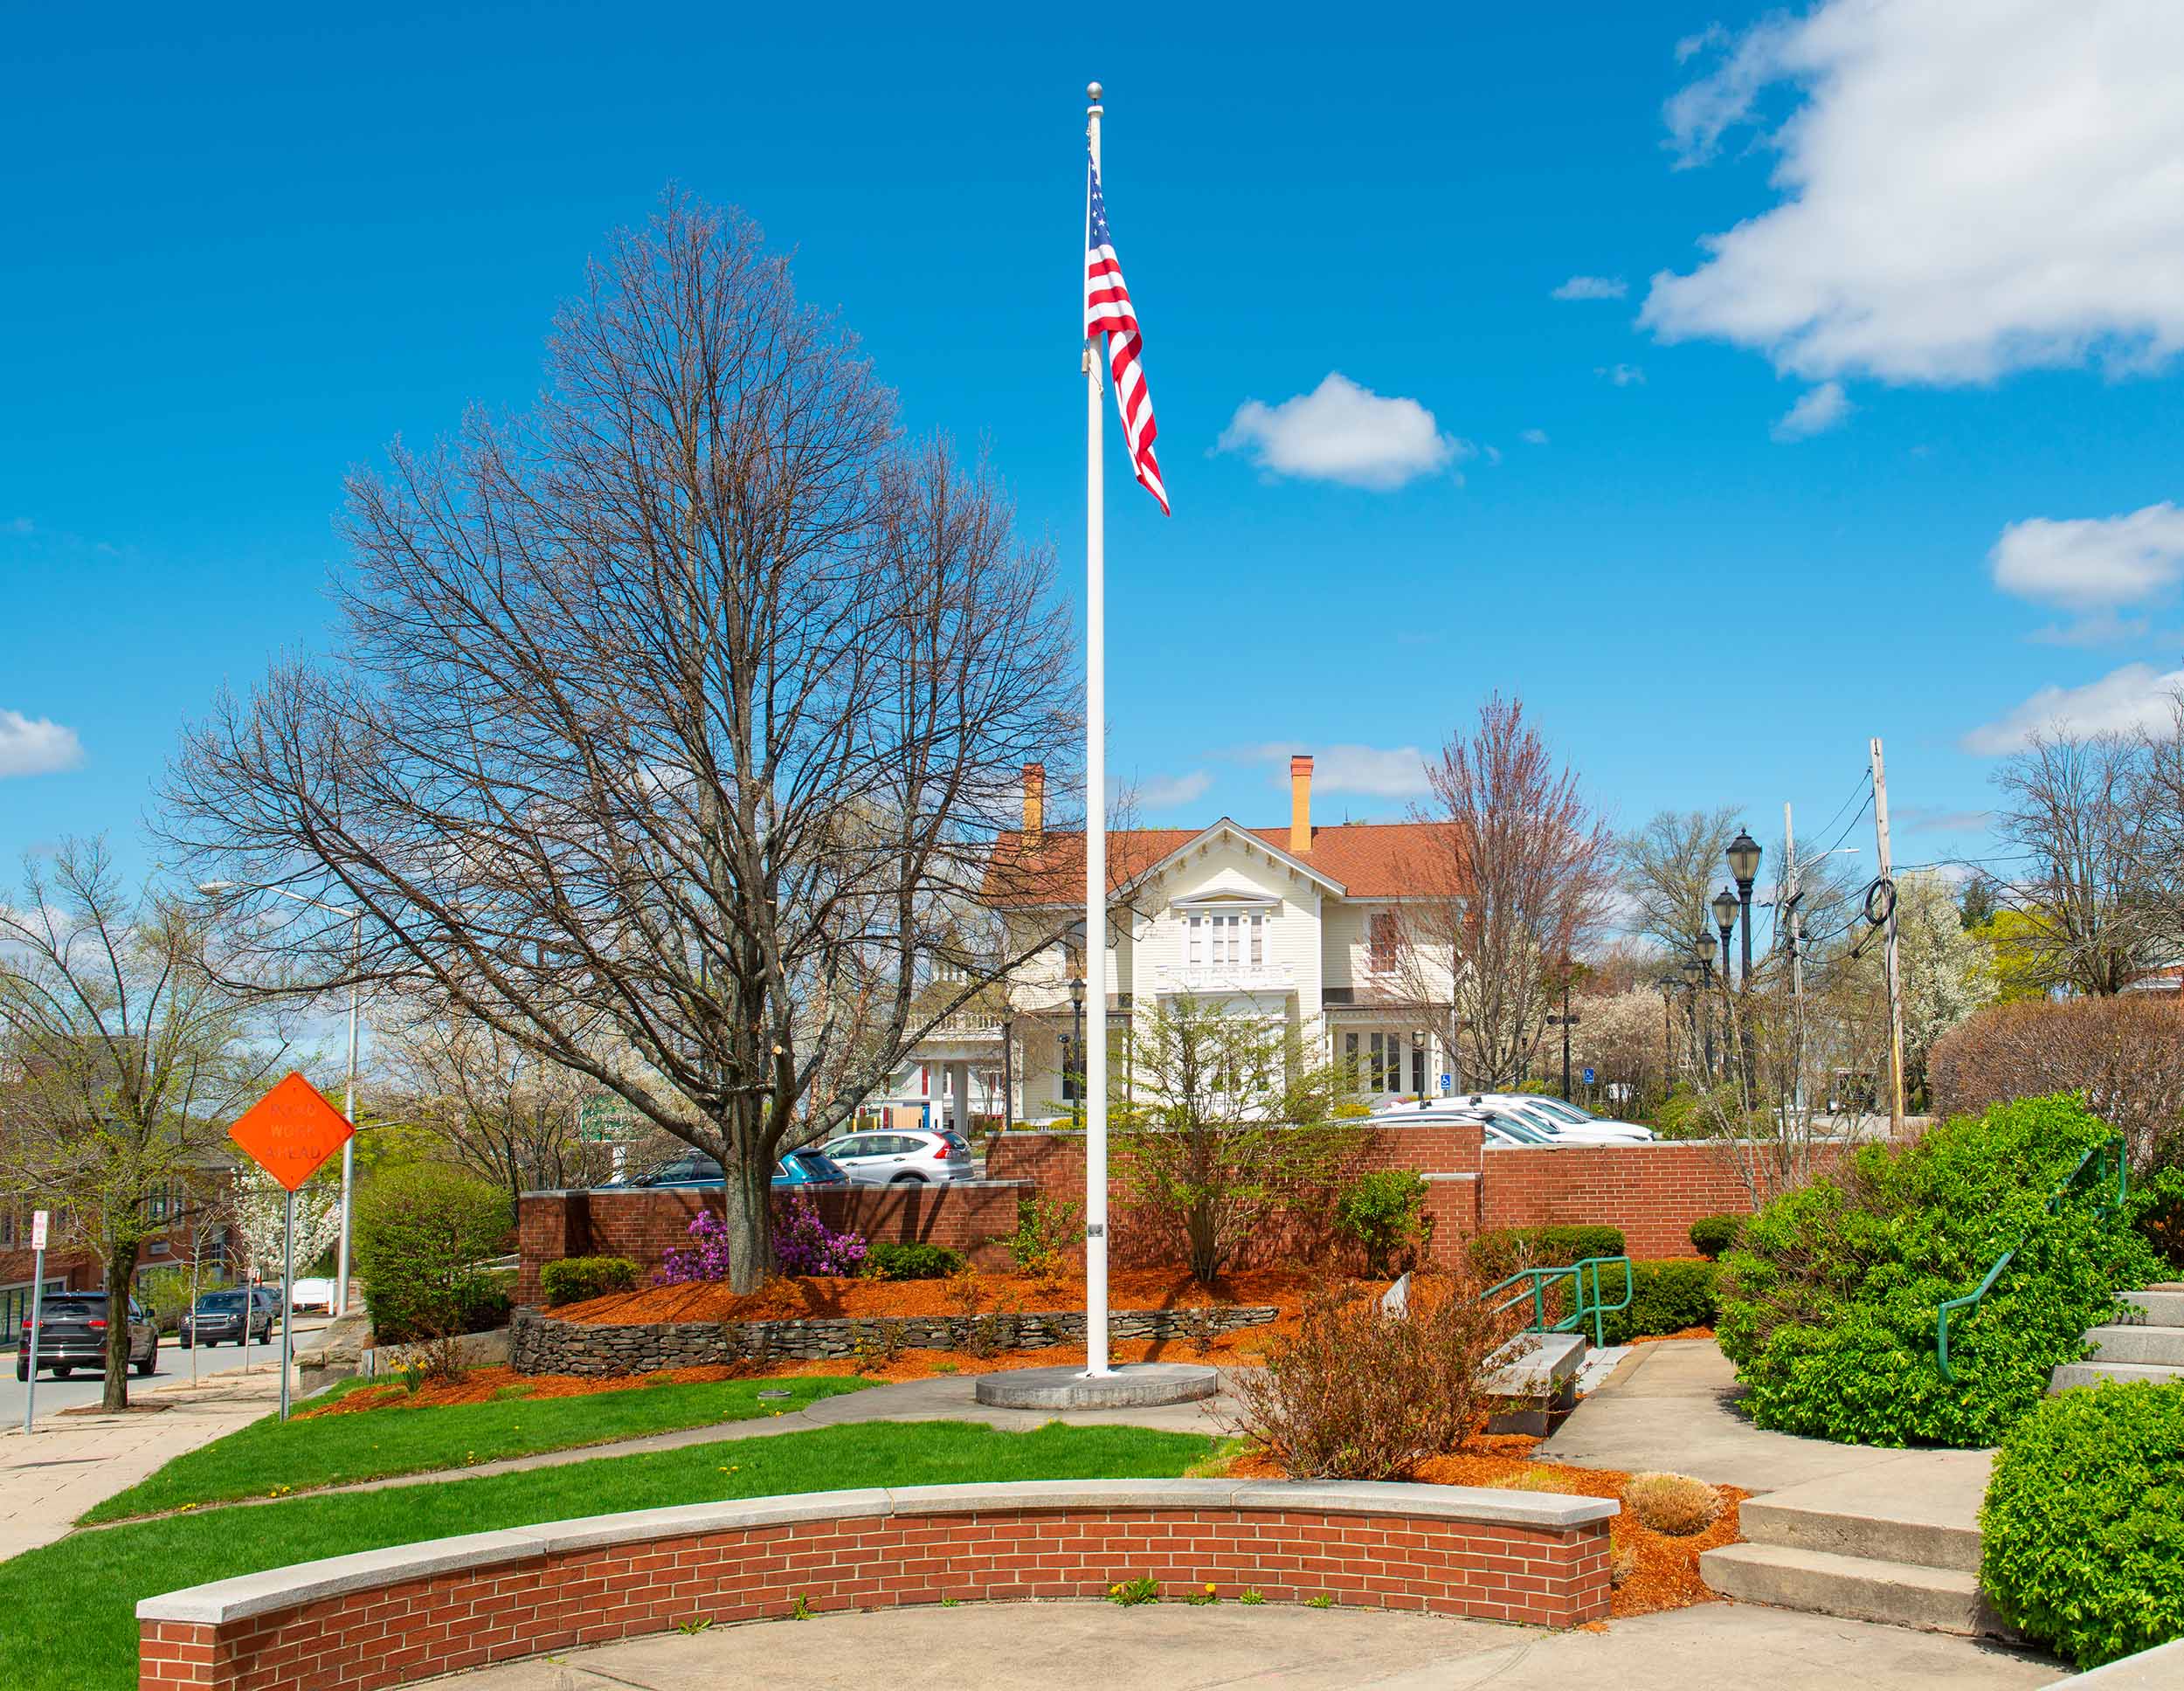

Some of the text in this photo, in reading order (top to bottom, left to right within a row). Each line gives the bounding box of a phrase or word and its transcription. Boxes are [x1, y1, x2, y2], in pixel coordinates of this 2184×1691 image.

[270, 1103, 316, 1117] ROAD
[270, 1124, 315, 1137] WORK
[266, 1146, 321, 1160] AHEAD
